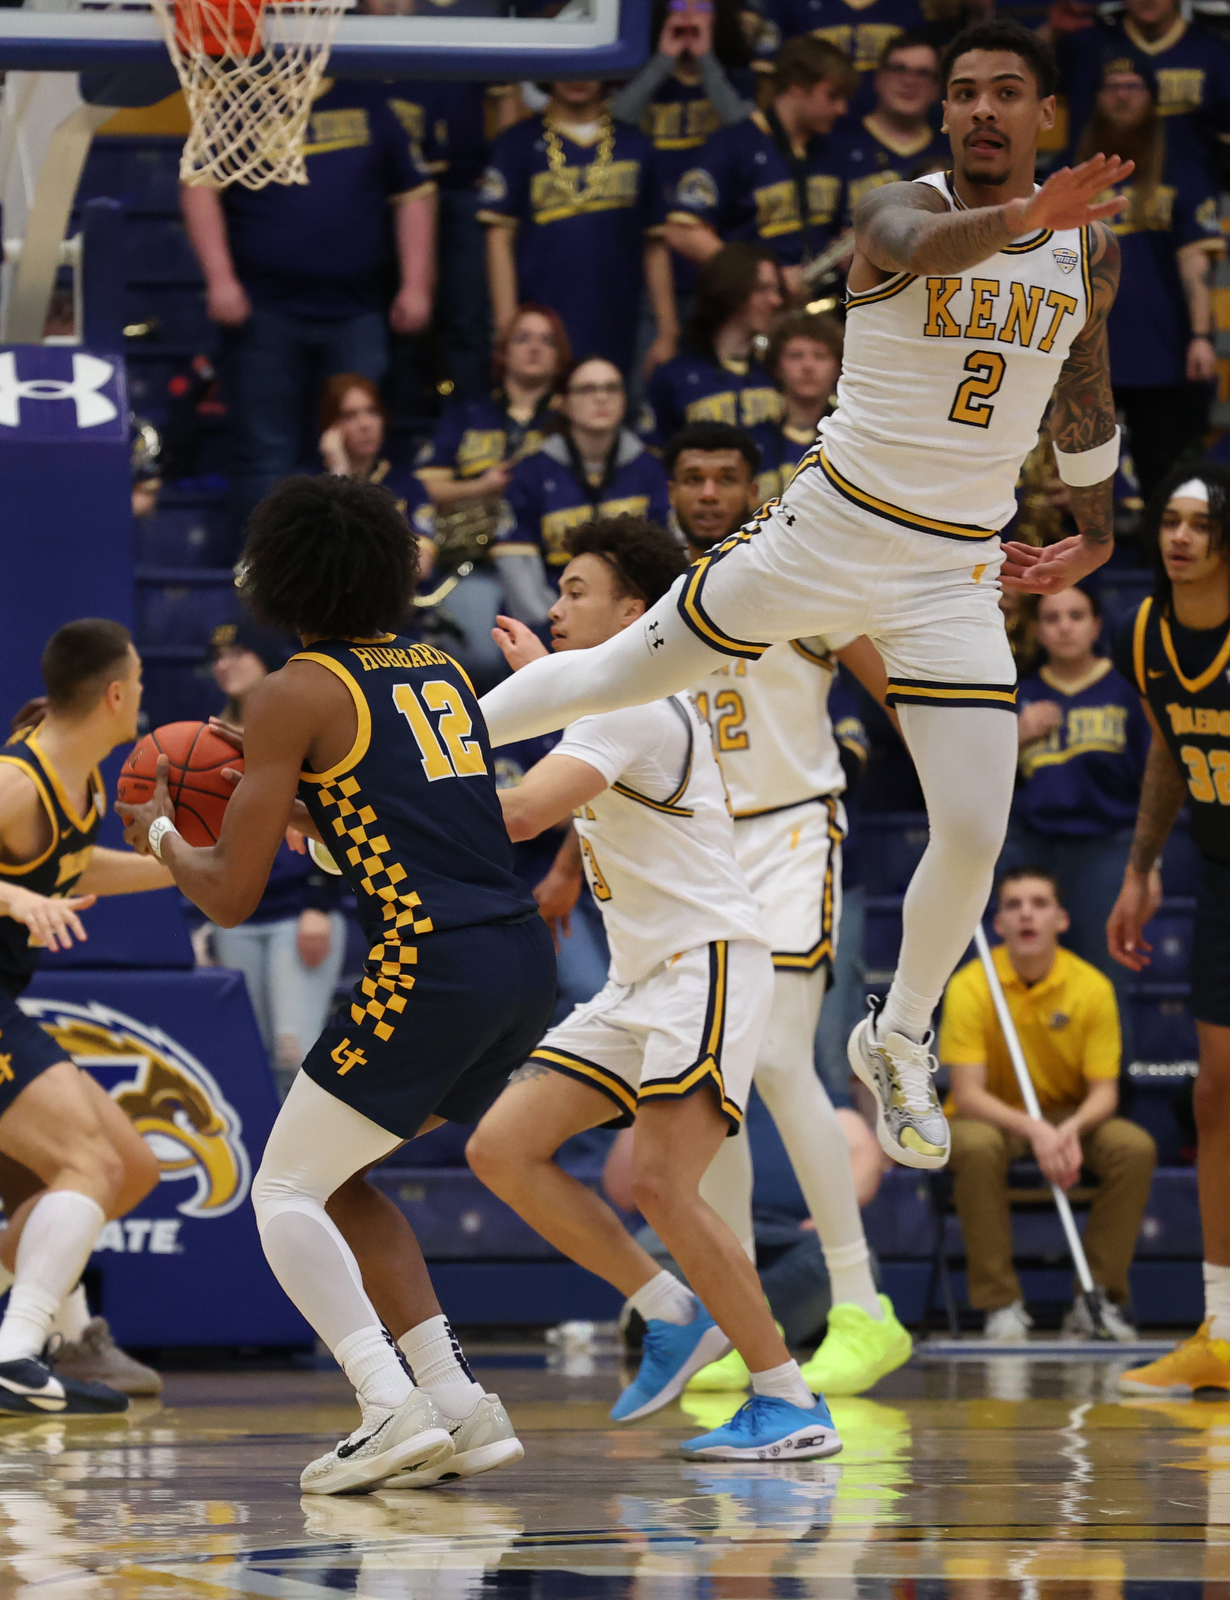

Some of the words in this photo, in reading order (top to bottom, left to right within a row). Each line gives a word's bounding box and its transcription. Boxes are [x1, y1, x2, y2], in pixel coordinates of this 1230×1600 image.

[924, 277, 1078, 353] KENT
[948, 350, 1007, 429] 2
[348, 643, 447, 672] HUBBARD
[392, 680, 489, 782] 12
[1180, 745, 1230, 806] 32
[94, 1218, 183, 1254] ATE
